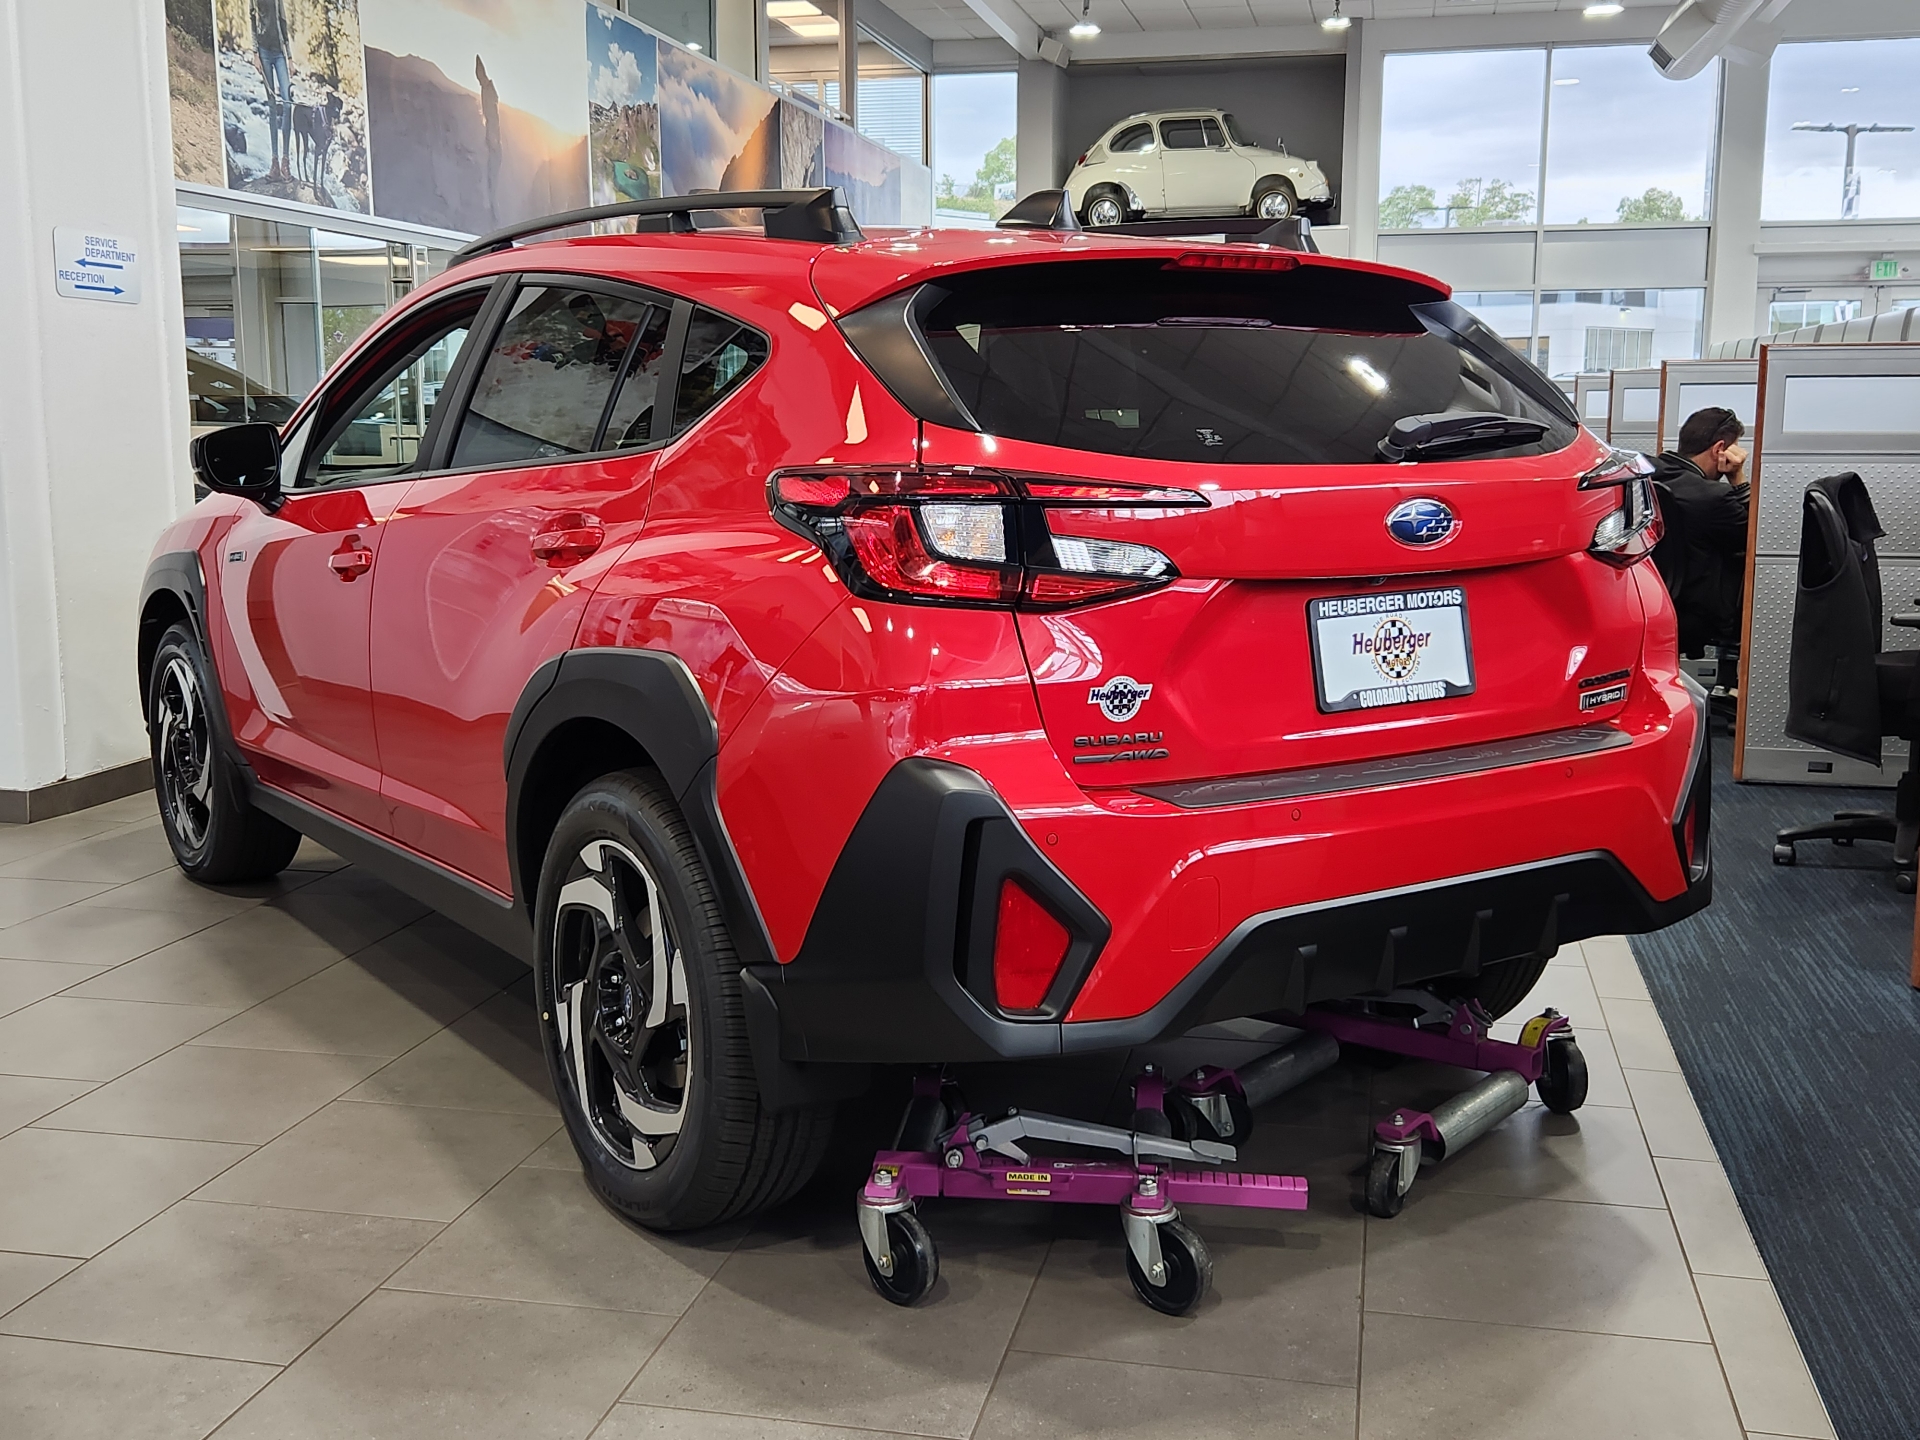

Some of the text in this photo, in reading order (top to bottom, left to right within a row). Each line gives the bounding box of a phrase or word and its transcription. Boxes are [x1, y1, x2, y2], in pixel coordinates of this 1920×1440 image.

[84, 235, 118, 250] SERVICE
[85, 247, 136, 263] DEPARTMENT
[58, 269, 105, 284] RECEPTION
[1875, 261, 1899, 278] EXIT
[1318, 589, 1462, 617] HEUBERGER MOTORS
[1352, 628, 1432, 655] Heuberger
[1090, 688, 1150, 702] Heuberger
[1359, 681, 1446, 708] COLORADO SPRINGS
[1589, 690, 1621, 705] HYBRID
[1074, 731, 1163, 747] SUBARU
[1109, 748, 1169, 762] AWD
[1008, 1173, 1048, 1181] MADE IN
